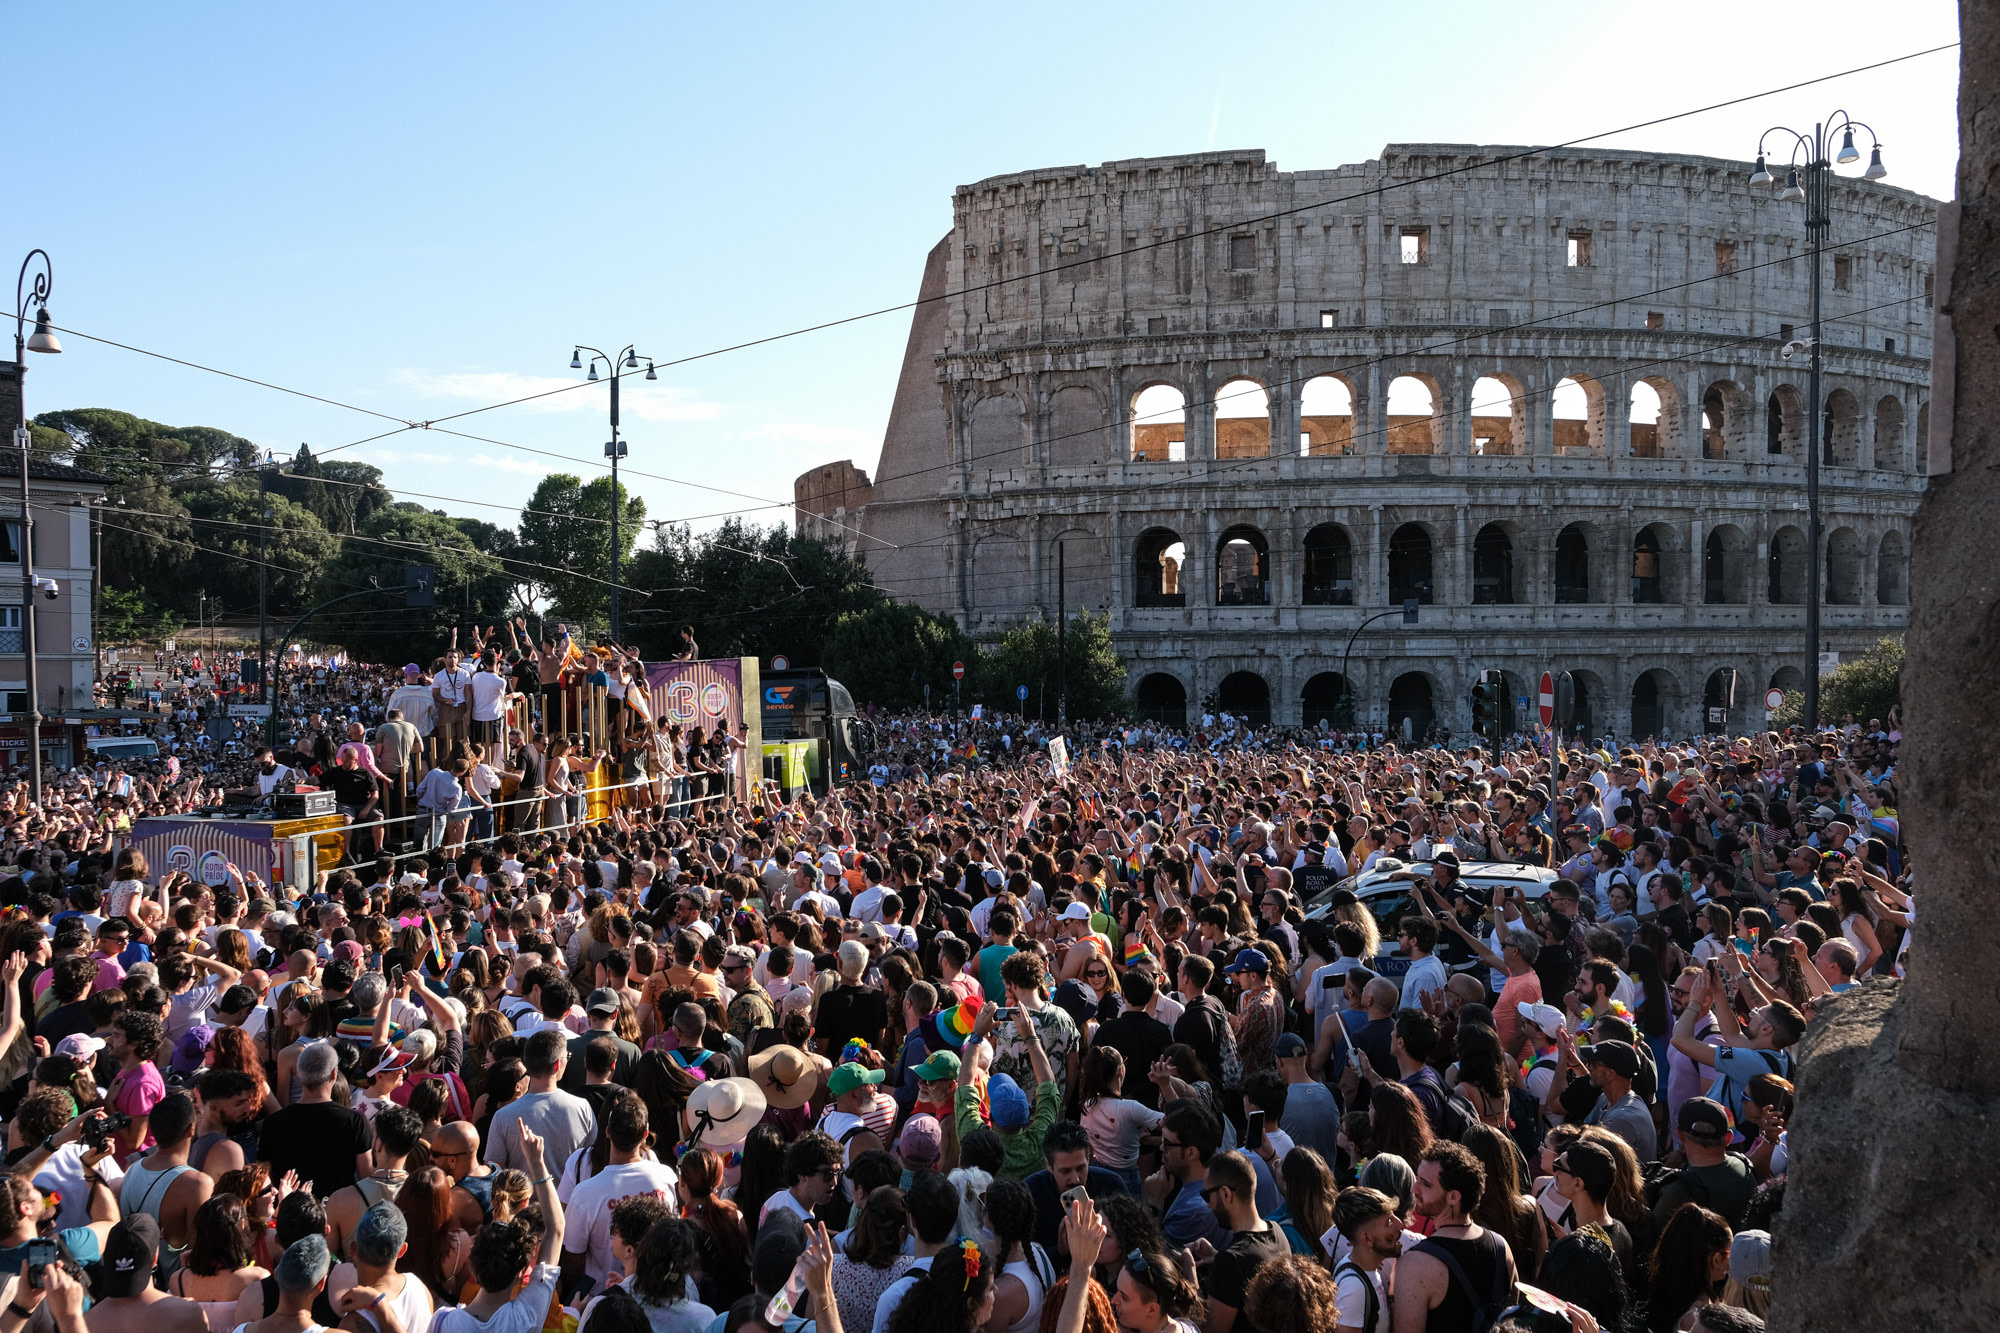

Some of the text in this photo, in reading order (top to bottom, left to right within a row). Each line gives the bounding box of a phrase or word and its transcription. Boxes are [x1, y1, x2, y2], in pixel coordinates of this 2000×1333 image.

[668, 681, 728, 723] 30
[204, 862, 224, 871] ROMA
[204, 871, 225, 880] PRIDE
[1754, 1284, 1770, 1292] ITAL
